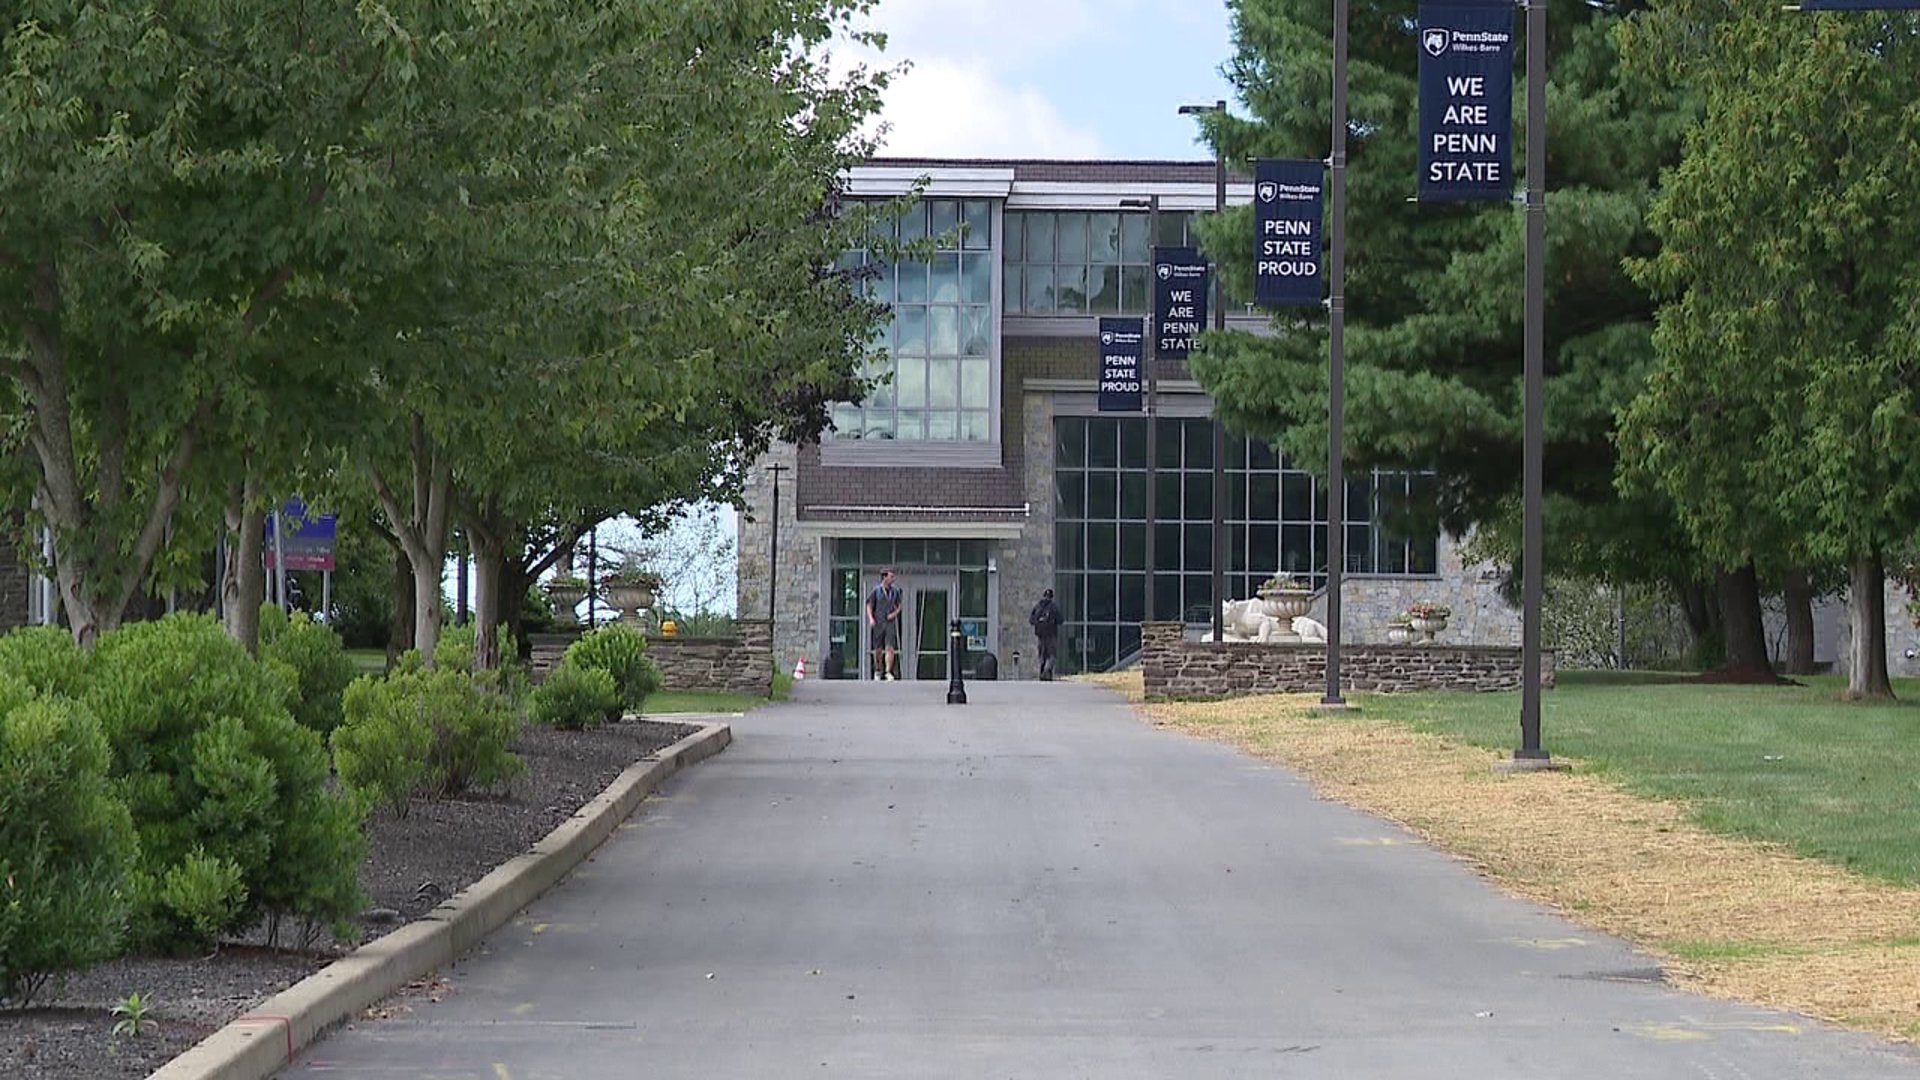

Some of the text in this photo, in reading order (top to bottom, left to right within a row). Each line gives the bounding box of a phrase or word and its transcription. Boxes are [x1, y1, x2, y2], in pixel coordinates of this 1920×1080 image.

[1447, 77, 1484, 96] WE
[1443, 106, 1488, 125] ARE
[1434, 134, 1496, 153] PENN
[1430, 162, 1500, 181] STATE
[1265, 221, 1311, 235] PENN
[1263, 241, 1311, 255] STATE
[1258, 261, 1317, 276] PROUD
[1170, 290, 1192, 302] WE
[1168, 306, 1194, 318] ARE
[1163, 322, 1199, 334] PENN
[1161, 338, 1201, 350] STATE
[1105, 355, 1137, 366] PENN
[1105, 369, 1137, 379] STATE
[1101, 381, 1140, 392] PROUD
